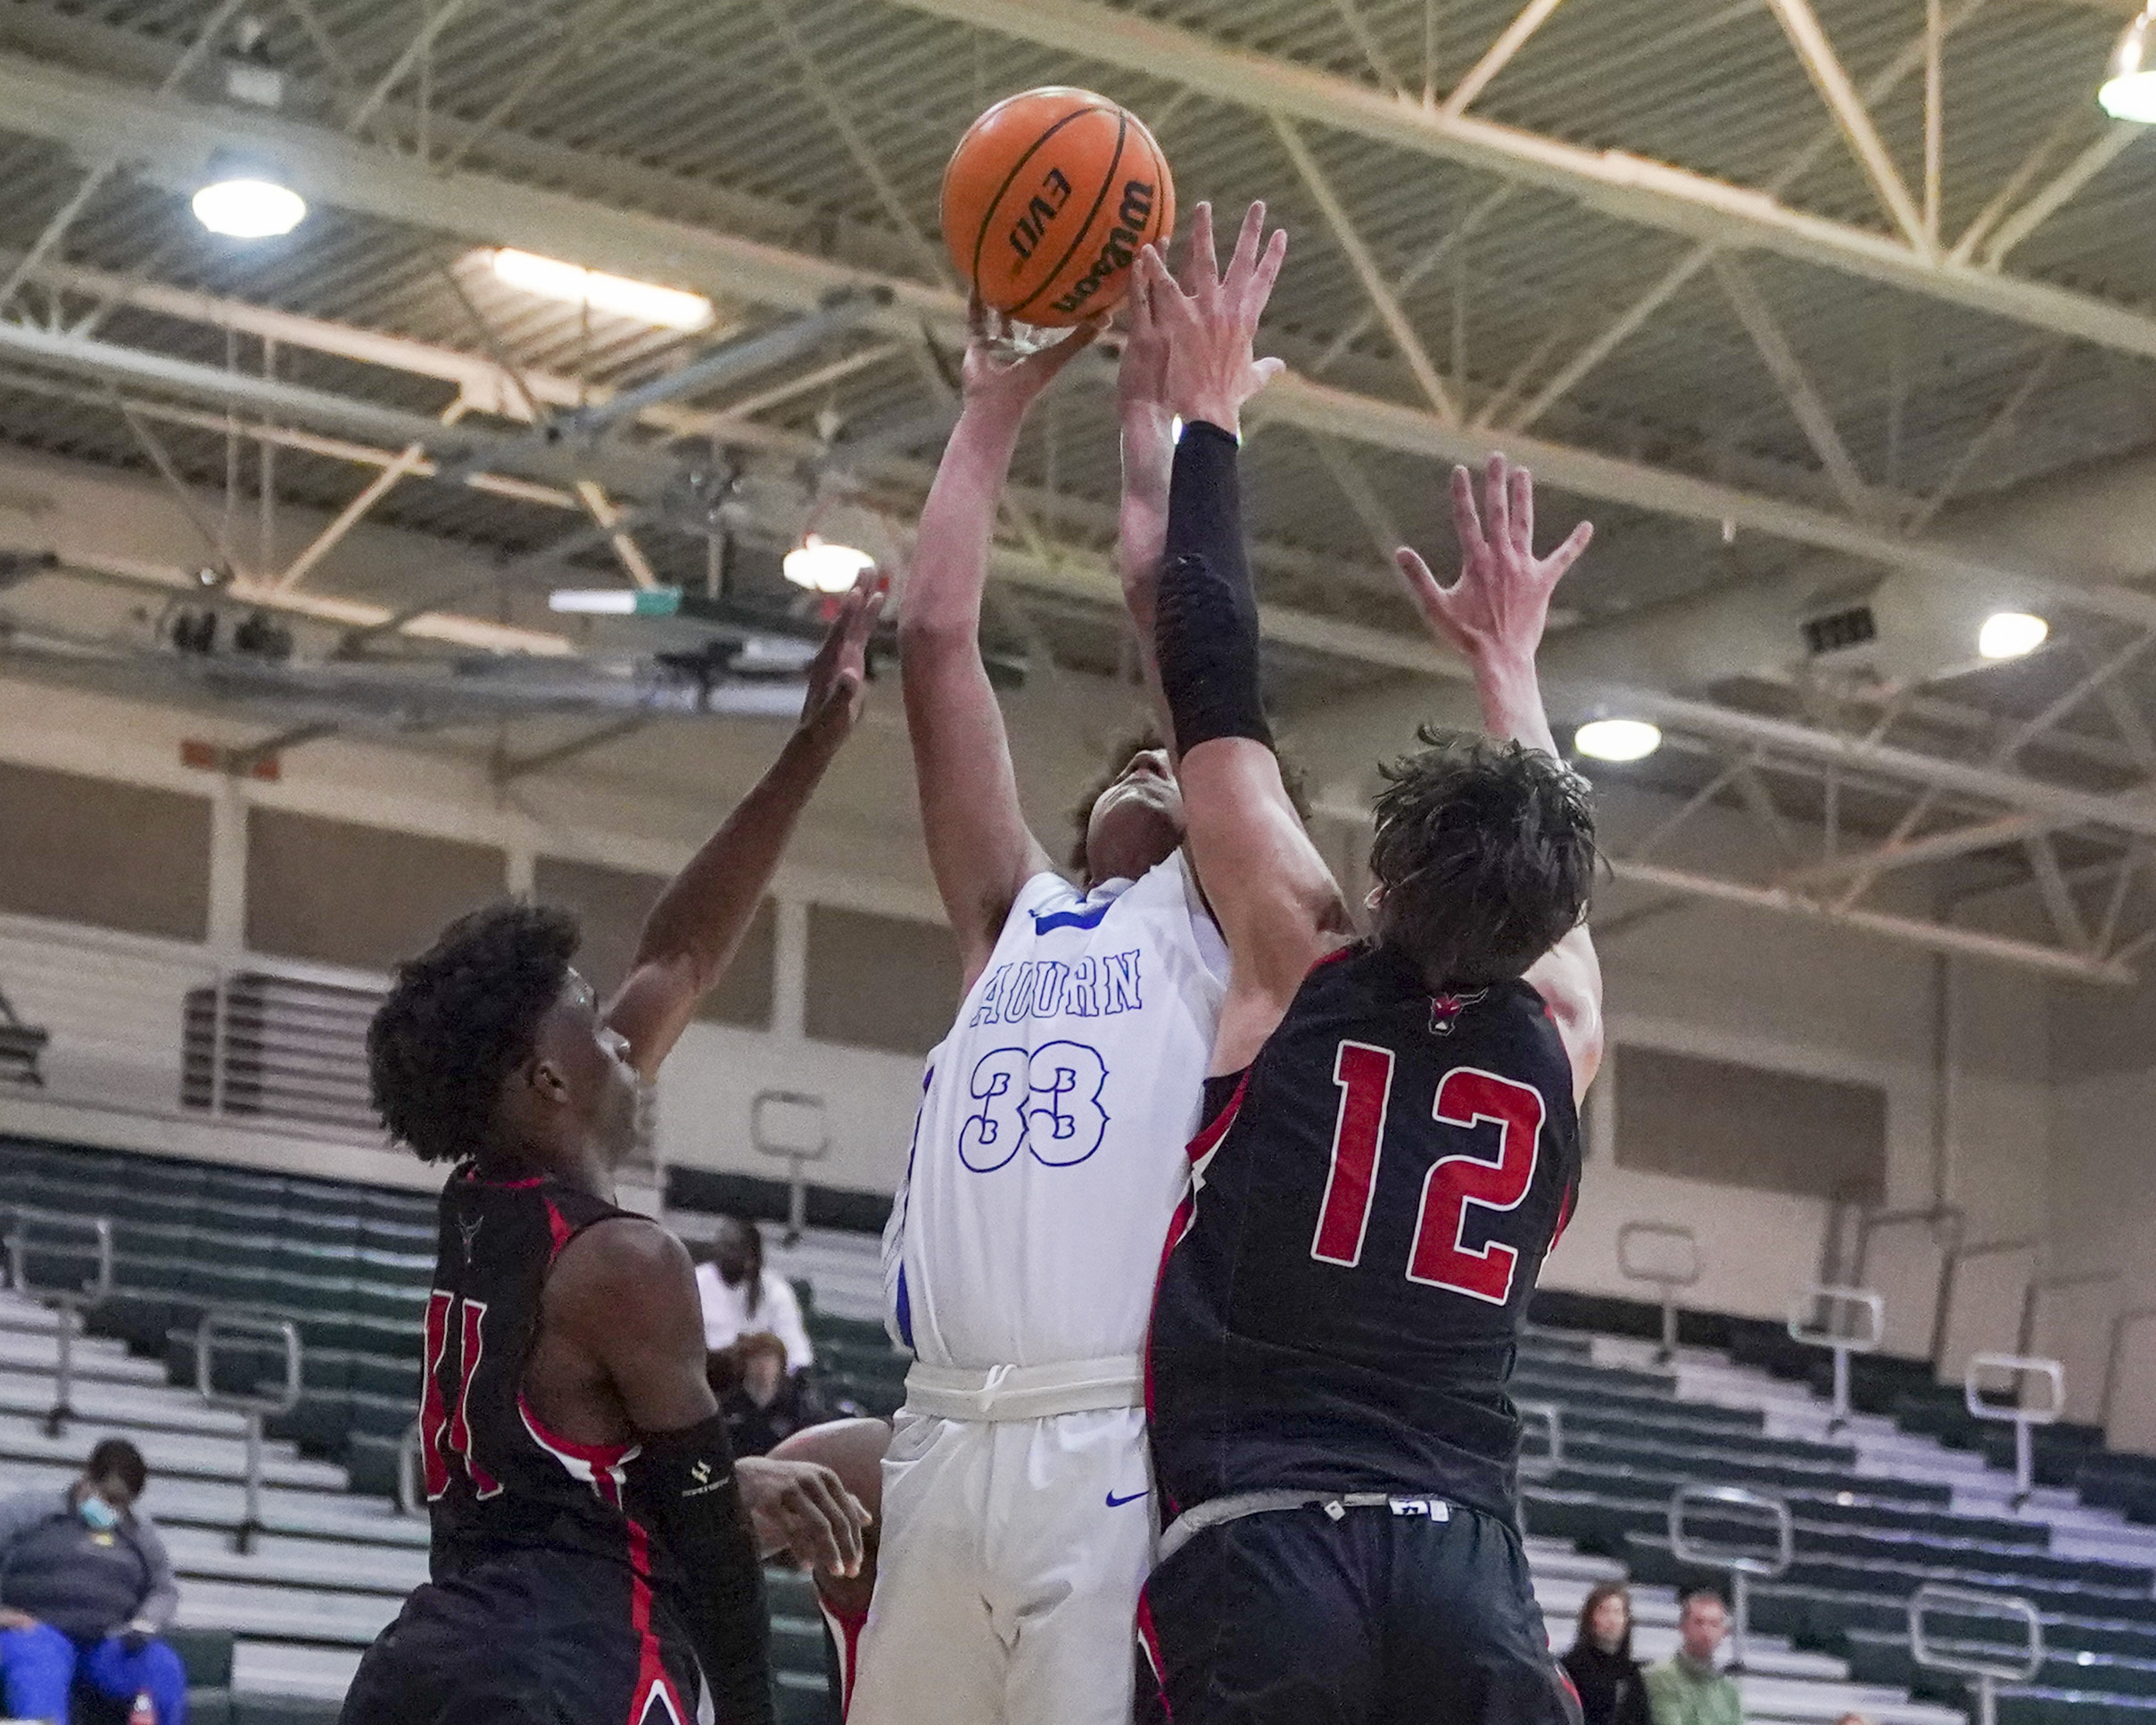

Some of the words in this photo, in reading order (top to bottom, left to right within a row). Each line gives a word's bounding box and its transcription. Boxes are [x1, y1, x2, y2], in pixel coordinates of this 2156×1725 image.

[1010, 167, 1071, 260] EVO
[958, 1039, 1111, 1174] 33
[1310, 1038, 1547, 1307] 12
